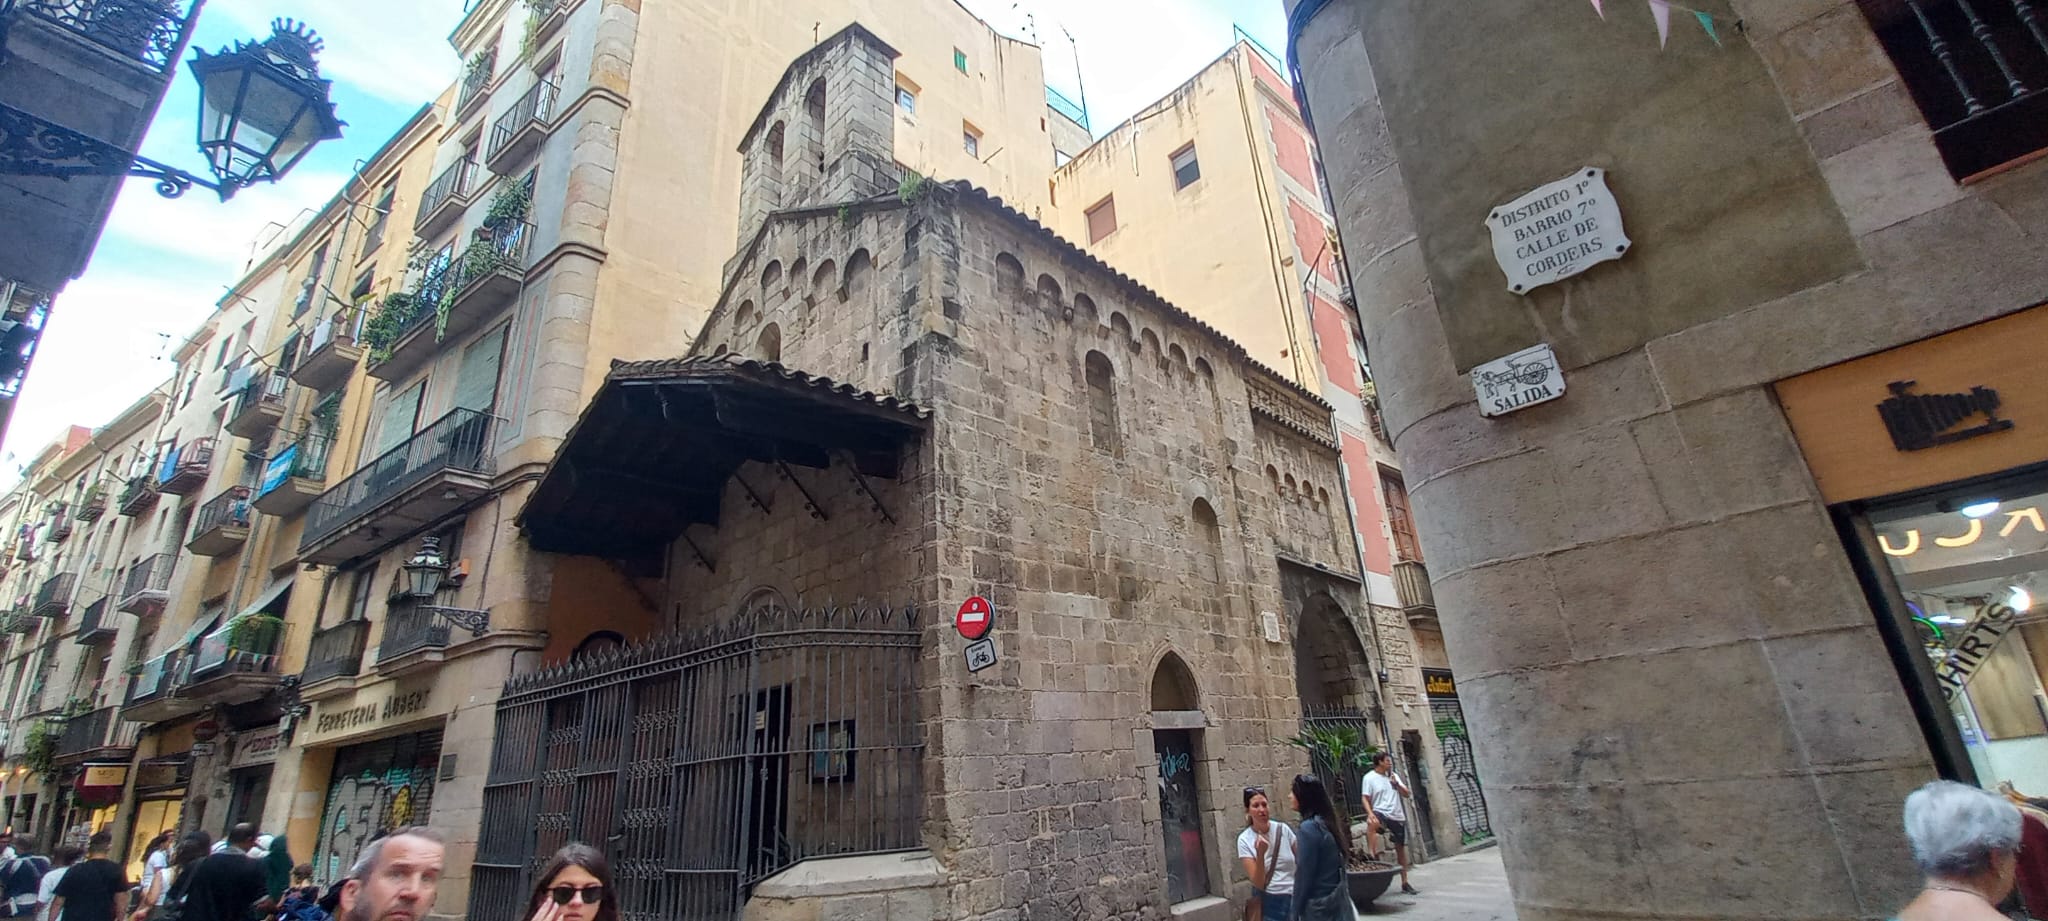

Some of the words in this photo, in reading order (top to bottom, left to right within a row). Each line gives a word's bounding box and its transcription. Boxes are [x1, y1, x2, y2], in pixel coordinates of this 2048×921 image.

[1501, 189, 1570, 228] DISTRITO
[1514, 208, 1573, 242] BARRIO
[1516, 229, 1570, 260] CALLE
[1574, 217, 1599, 237] DE
[1526, 237, 1603, 277] CORDERS
[1494, 384, 1553, 412] SALIDA
[316, 702, 378, 734] FERRETERIA
[382, 688, 431, 720] AUBERT
